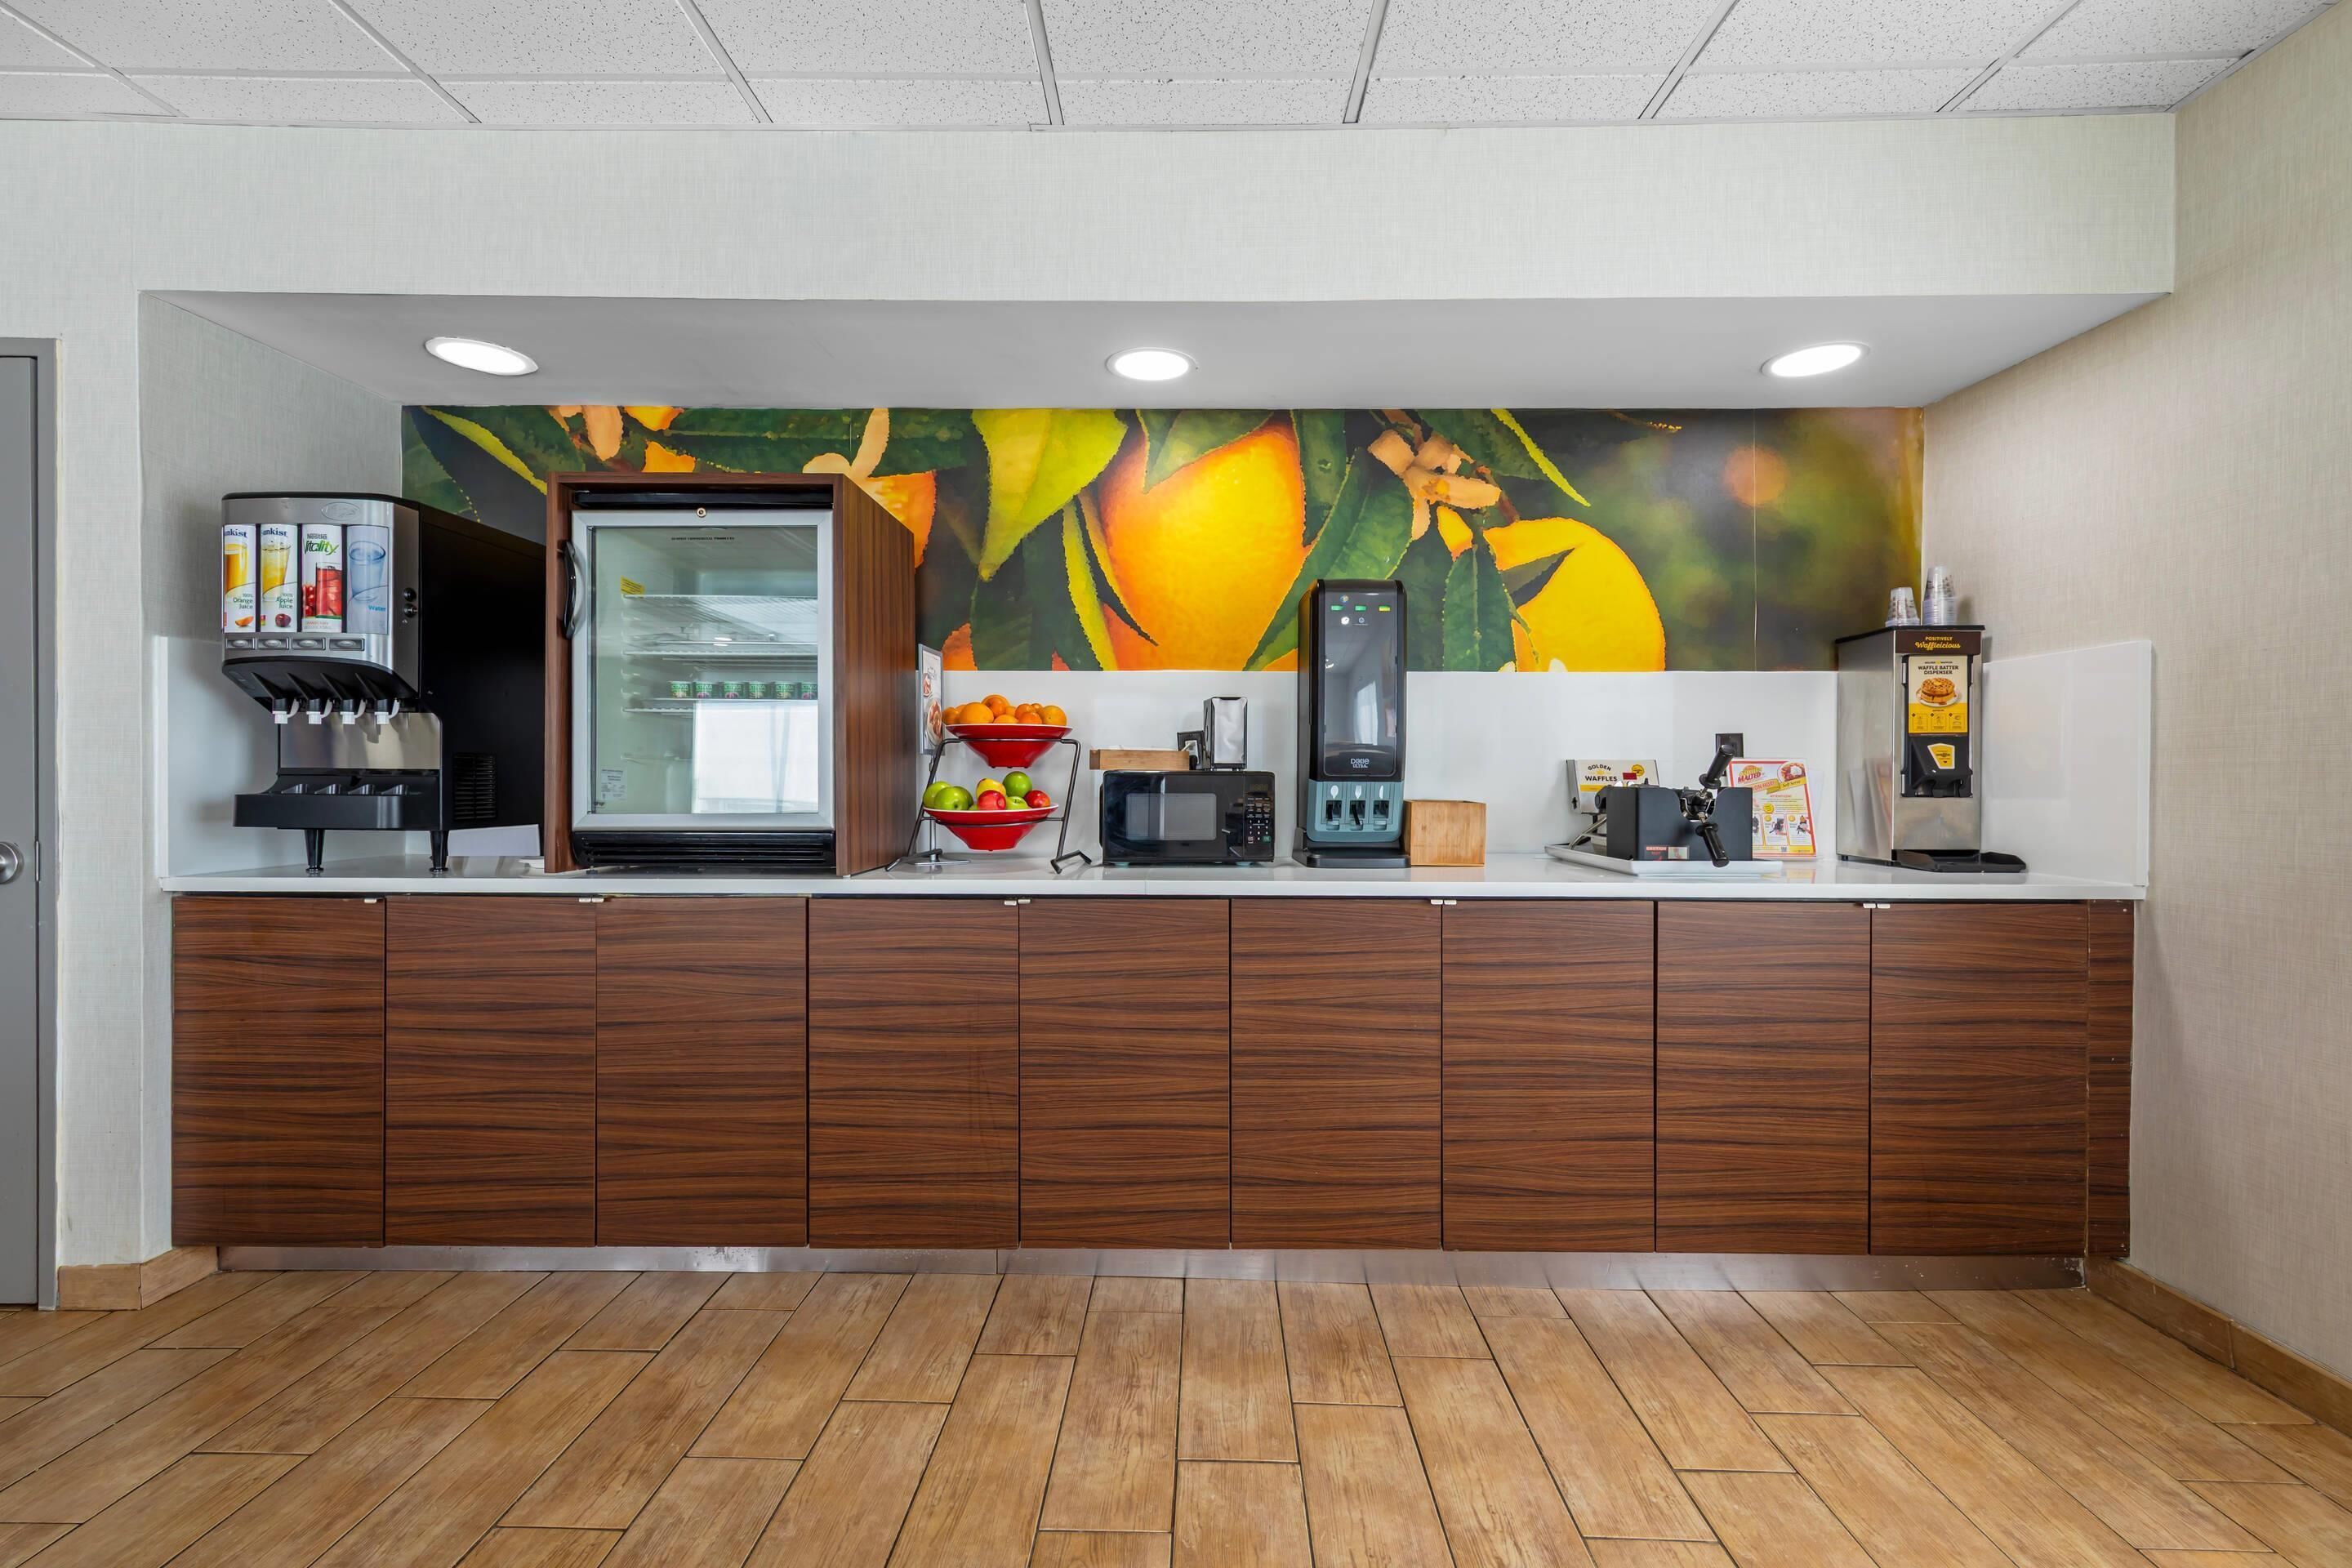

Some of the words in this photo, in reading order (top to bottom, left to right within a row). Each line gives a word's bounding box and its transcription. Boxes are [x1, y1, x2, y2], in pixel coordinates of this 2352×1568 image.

[225, 528, 247, 538] unkist
[261, 527, 288, 537] unkist
[303, 538, 339, 556] Vitality
[276, 596, 293, 604] Apple
[1737, 771, 1762, 783] MALTED
